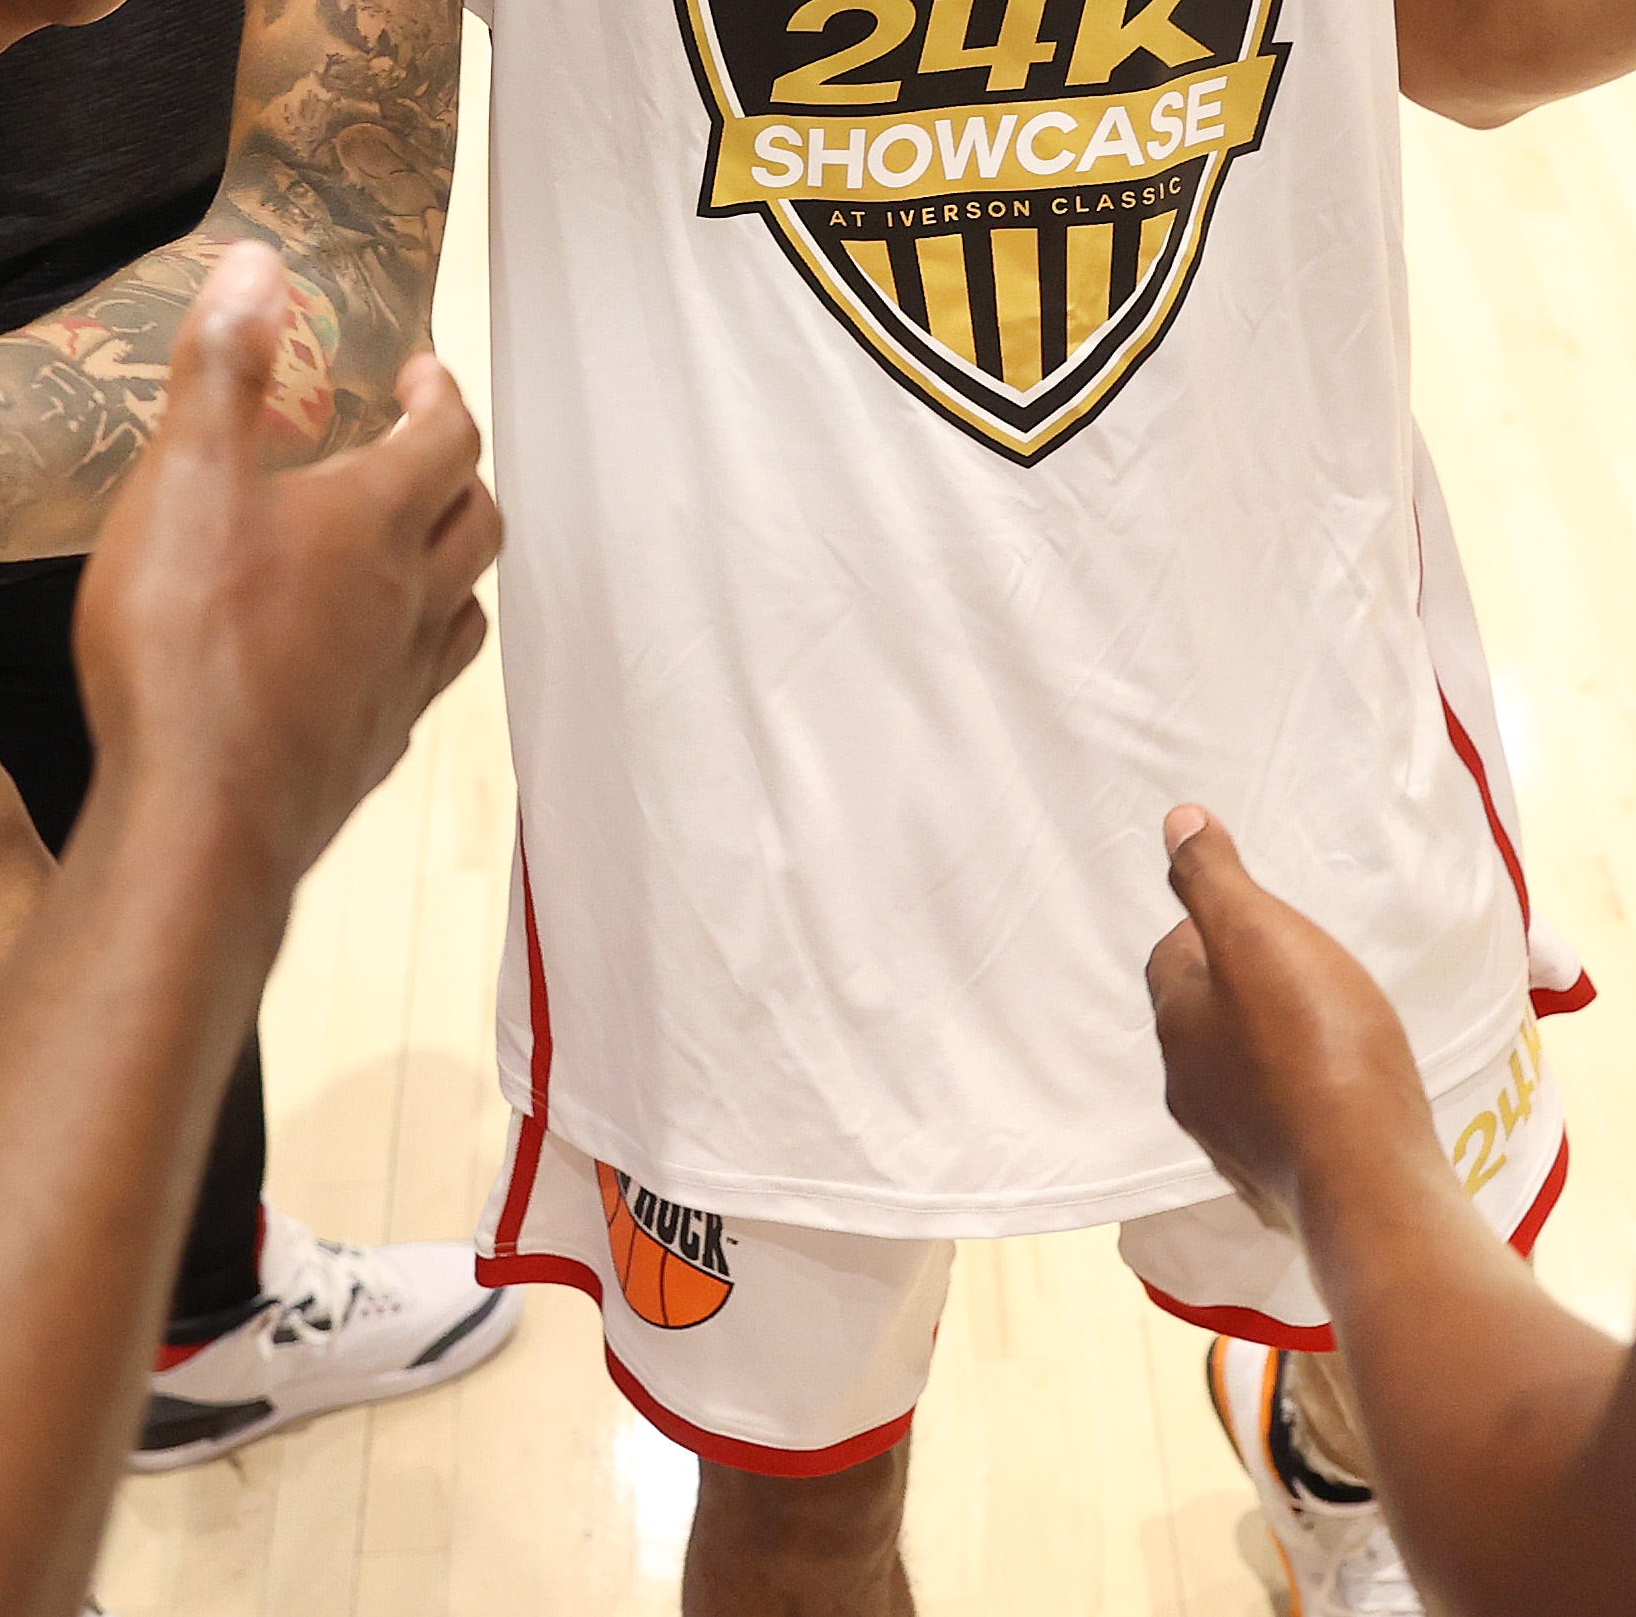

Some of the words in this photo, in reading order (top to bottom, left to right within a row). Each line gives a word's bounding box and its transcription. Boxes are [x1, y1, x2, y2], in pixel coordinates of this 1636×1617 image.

[751, 76, 1228, 190] SHOWCASE
[829, 209, 866, 227] AT
[887, 199, 1032, 228] IVERSON
[1051, 176, 1182, 215] CLASSIC
